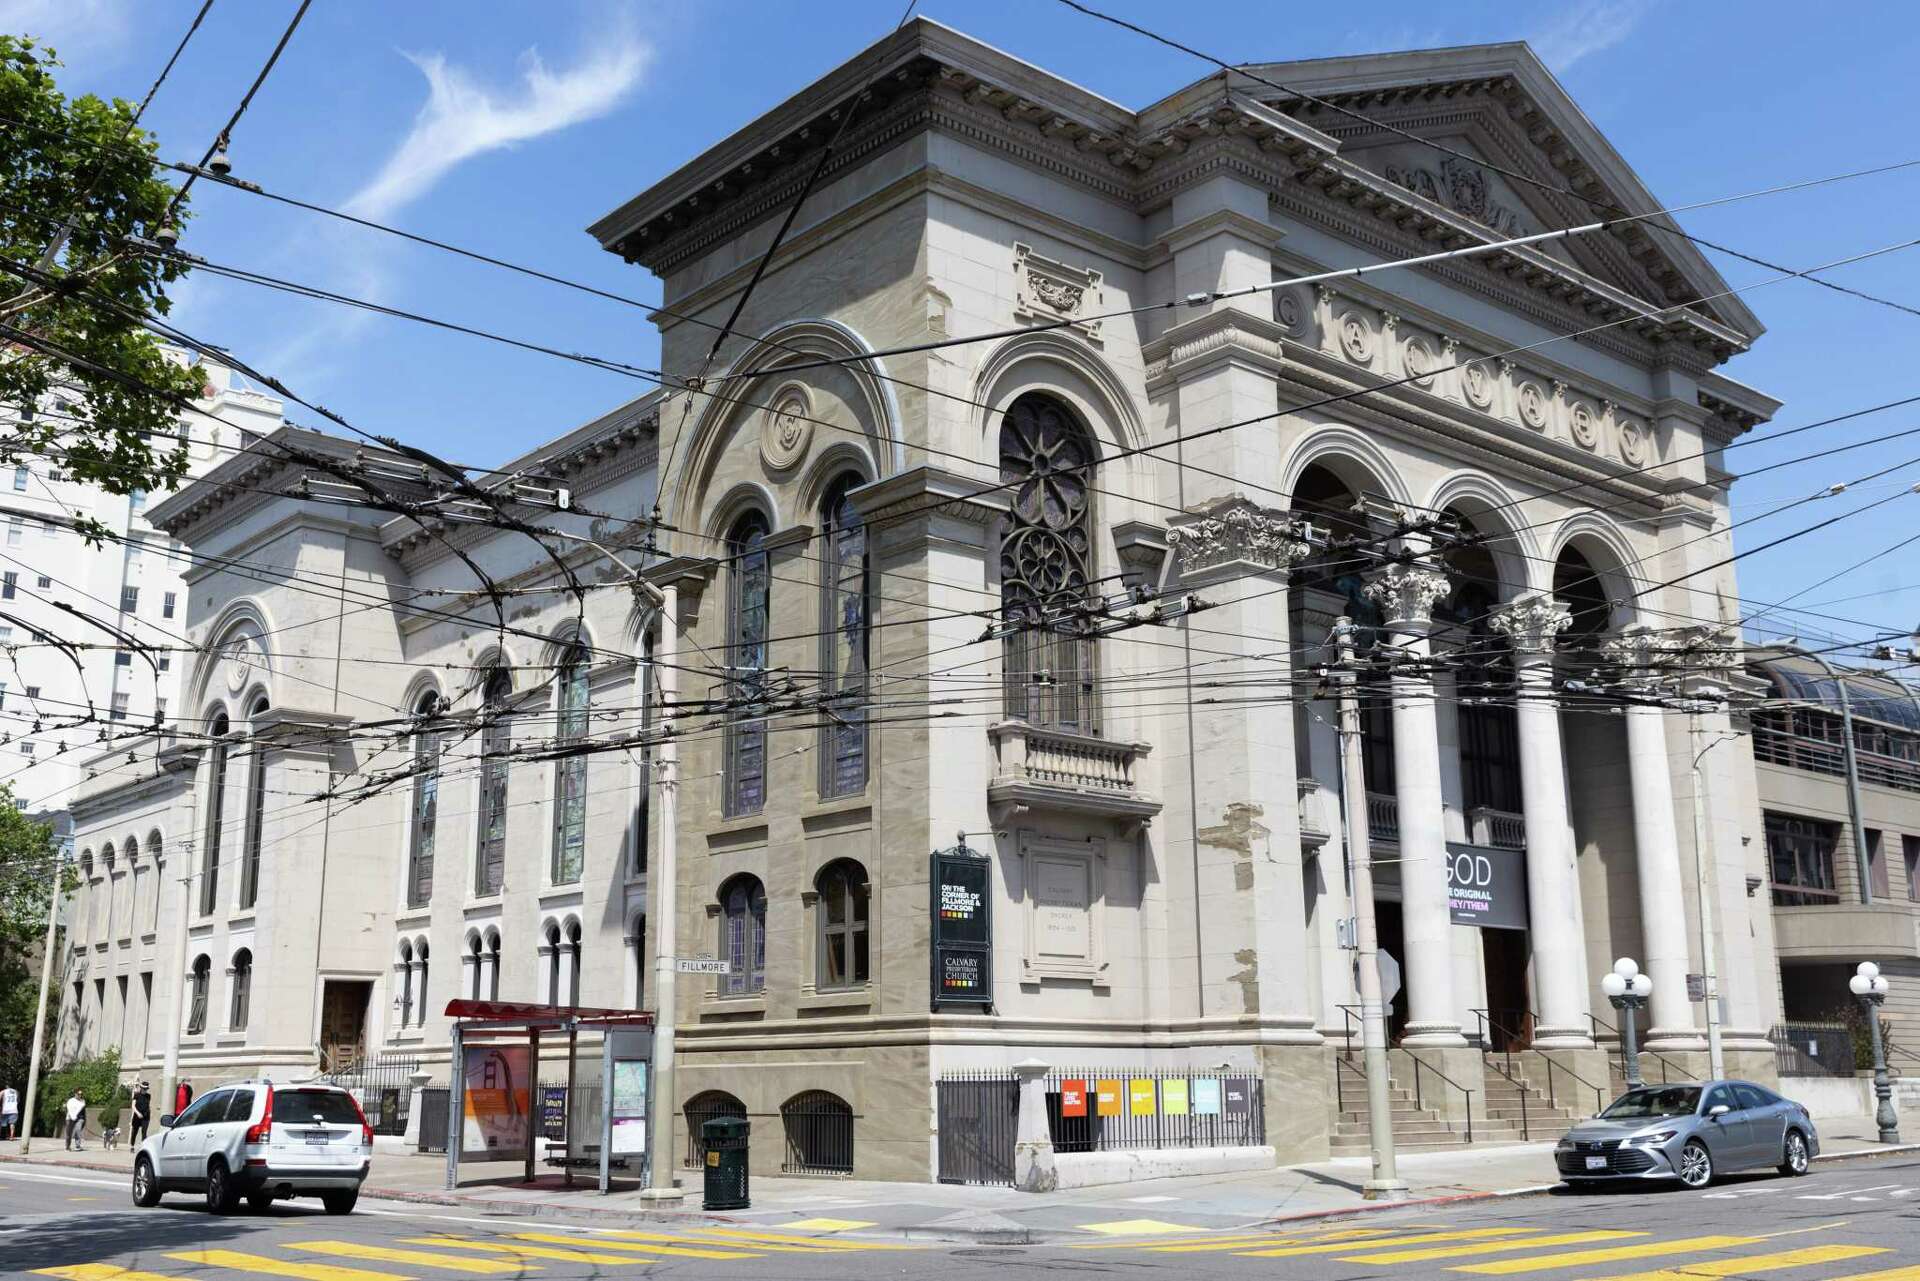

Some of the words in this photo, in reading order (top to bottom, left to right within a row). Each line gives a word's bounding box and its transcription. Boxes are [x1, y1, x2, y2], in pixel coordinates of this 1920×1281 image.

[1446, 852, 1492, 886] GOD
[942, 891, 969, 899] CORNER
[1454, 888, 1493, 900] ORIGINAL
[942, 897, 974, 906] FILLMORE
[1449, 899, 1490, 912] HEY/THEM
[942, 904, 974, 912] JACKSON
[682, 962, 725, 972] FILLMORE
[945, 957, 978, 967] CALVARY
[945, 972, 978, 981] CHURCH
